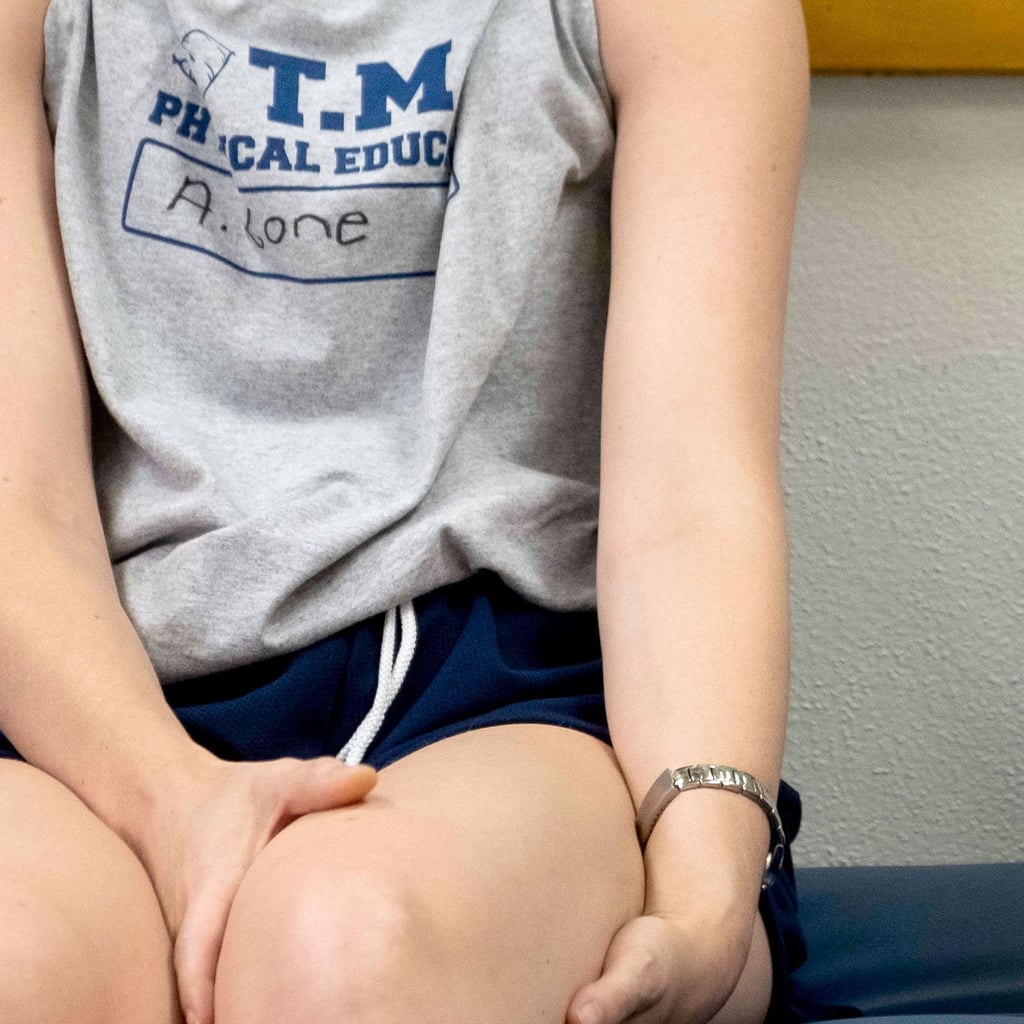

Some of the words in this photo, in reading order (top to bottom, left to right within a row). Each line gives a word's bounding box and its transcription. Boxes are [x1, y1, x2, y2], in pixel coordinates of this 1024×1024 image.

[248, 39, 454, 132] T.M
[334, 130, 449, 175] EDUC
[166, 176, 228, 232] A.
